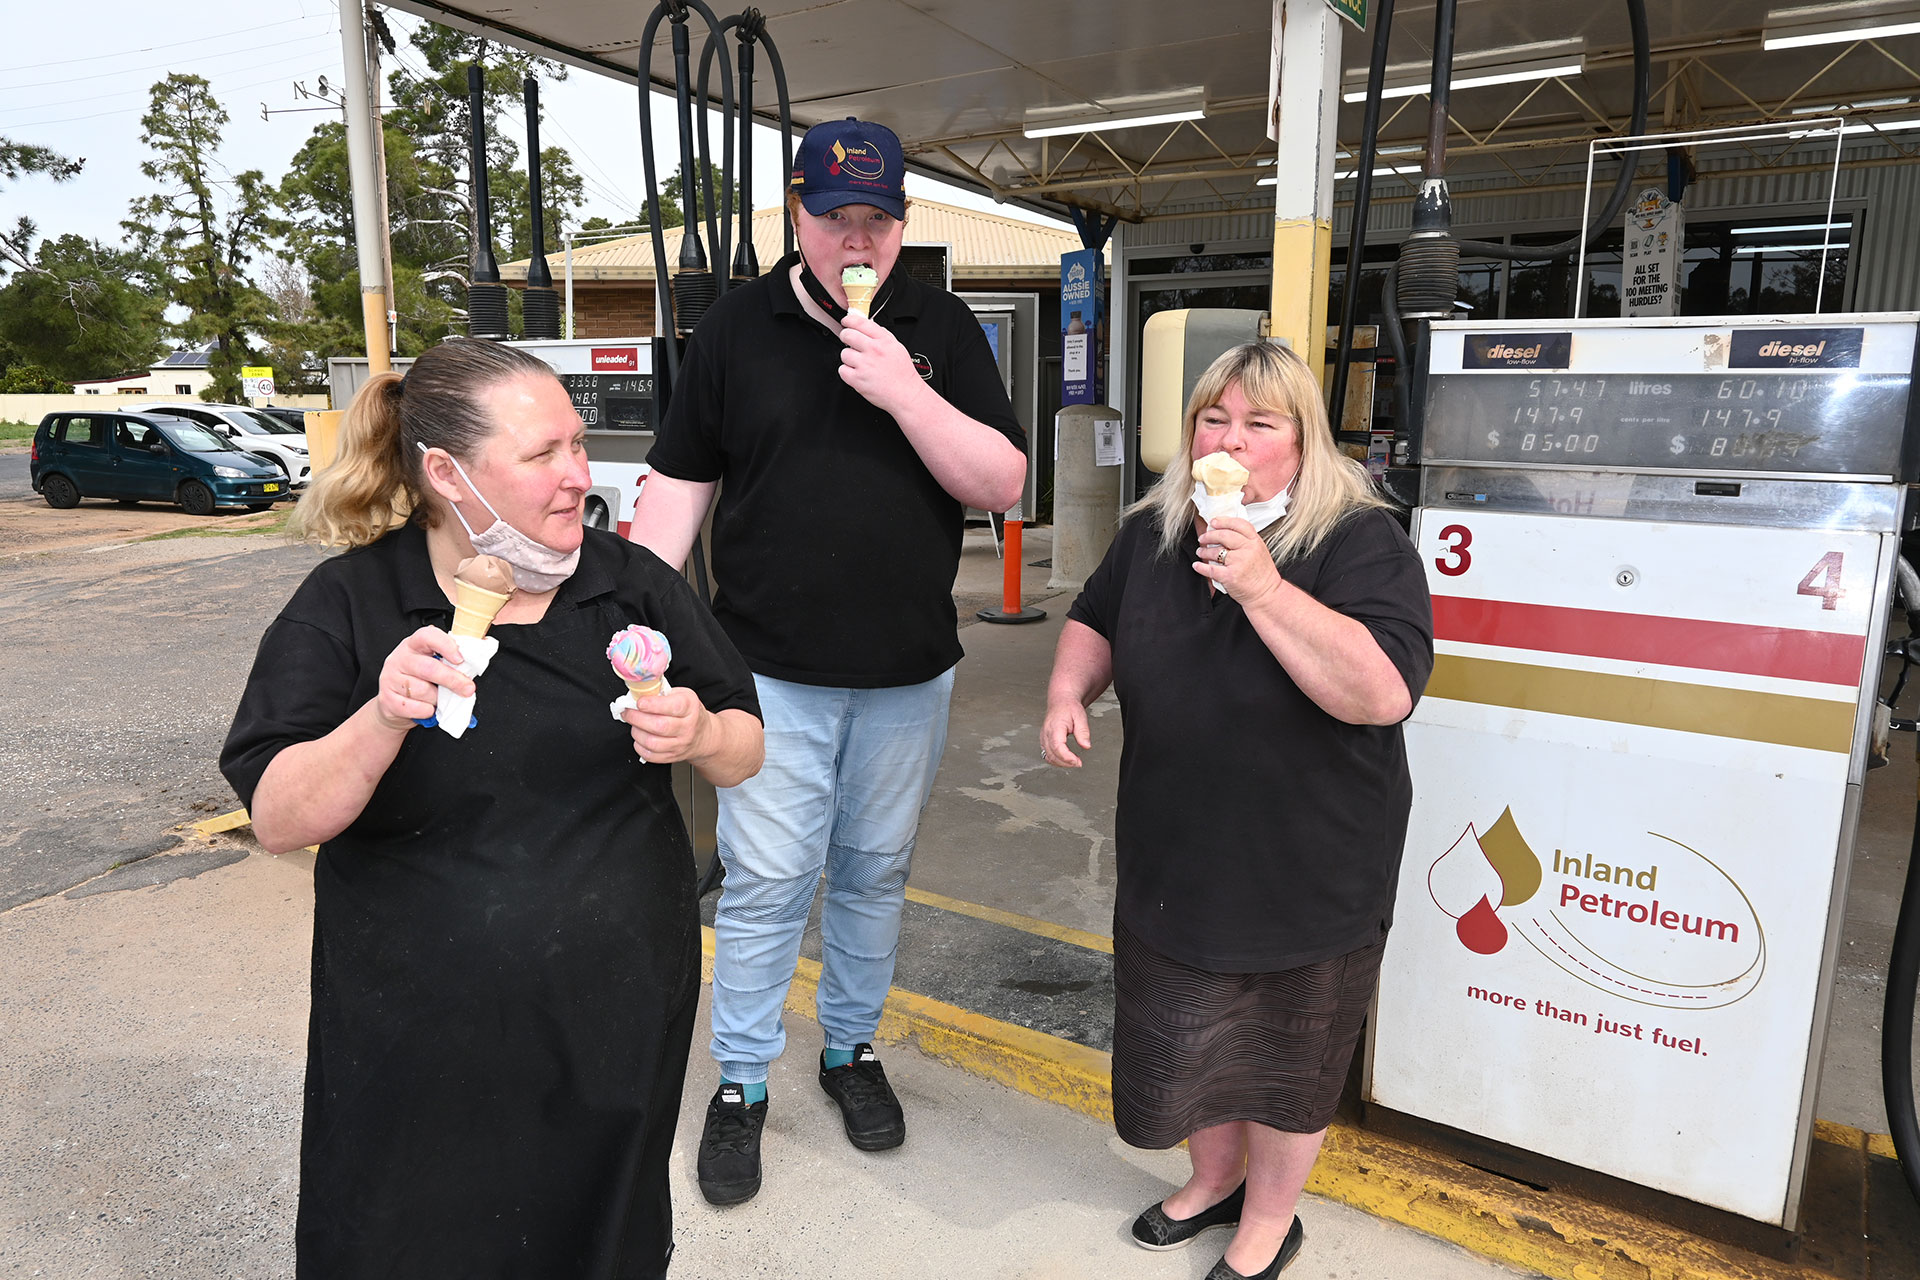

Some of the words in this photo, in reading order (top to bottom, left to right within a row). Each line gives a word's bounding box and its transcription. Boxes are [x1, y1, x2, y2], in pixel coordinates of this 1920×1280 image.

[846, 147, 867, 155] Inland
[848, 154, 881, 164] Petroleum
[1634, 264, 1646, 275] ALL
[1648, 262, 1660, 273] SET
[1062, 279, 1090, 293] AUSSIE
[1633, 275, 1646, 286] FOR
[1648, 273, 1661, 284] THE
[1062, 289, 1091, 301] OWNED
[1625, 286, 1637, 298] 100
[1638, 283, 1668, 296] MEETING
[1628, 294, 1663, 308] HURDLES?
[1487, 343, 1542, 359] diesel
[1758, 340, 1826, 357] diesel
[596, 355, 628, 364] unleaded
[1789, 356, 1819, 365] hi-flow
[261, 383, 271, 391] 40
[625, 380, 653, 392] 146.9
[1529, 379, 1606, 398] 57.47
[1629, 381, 1672, 395] litres
[571, 393, 597, 405] 148.9
[1514, 407, 1583, 424] 147.9
[1702, 409, 1782, 428] 147.9
[1487, 429, 1500, 449] $
[1521, 434, 1599, 452] 85.00
[1670, 434, 1685, 455] $
[1435, 524, 1473, 576] 3
[1797, 551, 1846, 610] 4
[1552, 848, 1658, 892] Inland
[1559, 883, 1740, 943] Petroleum
[1466, 985, 1527, 1011] more
[1535, 999, 1588, 1027] than
[1594, 1013, 1643, 1041] just
[1651, 1027, 1708, 1057] fuel.
